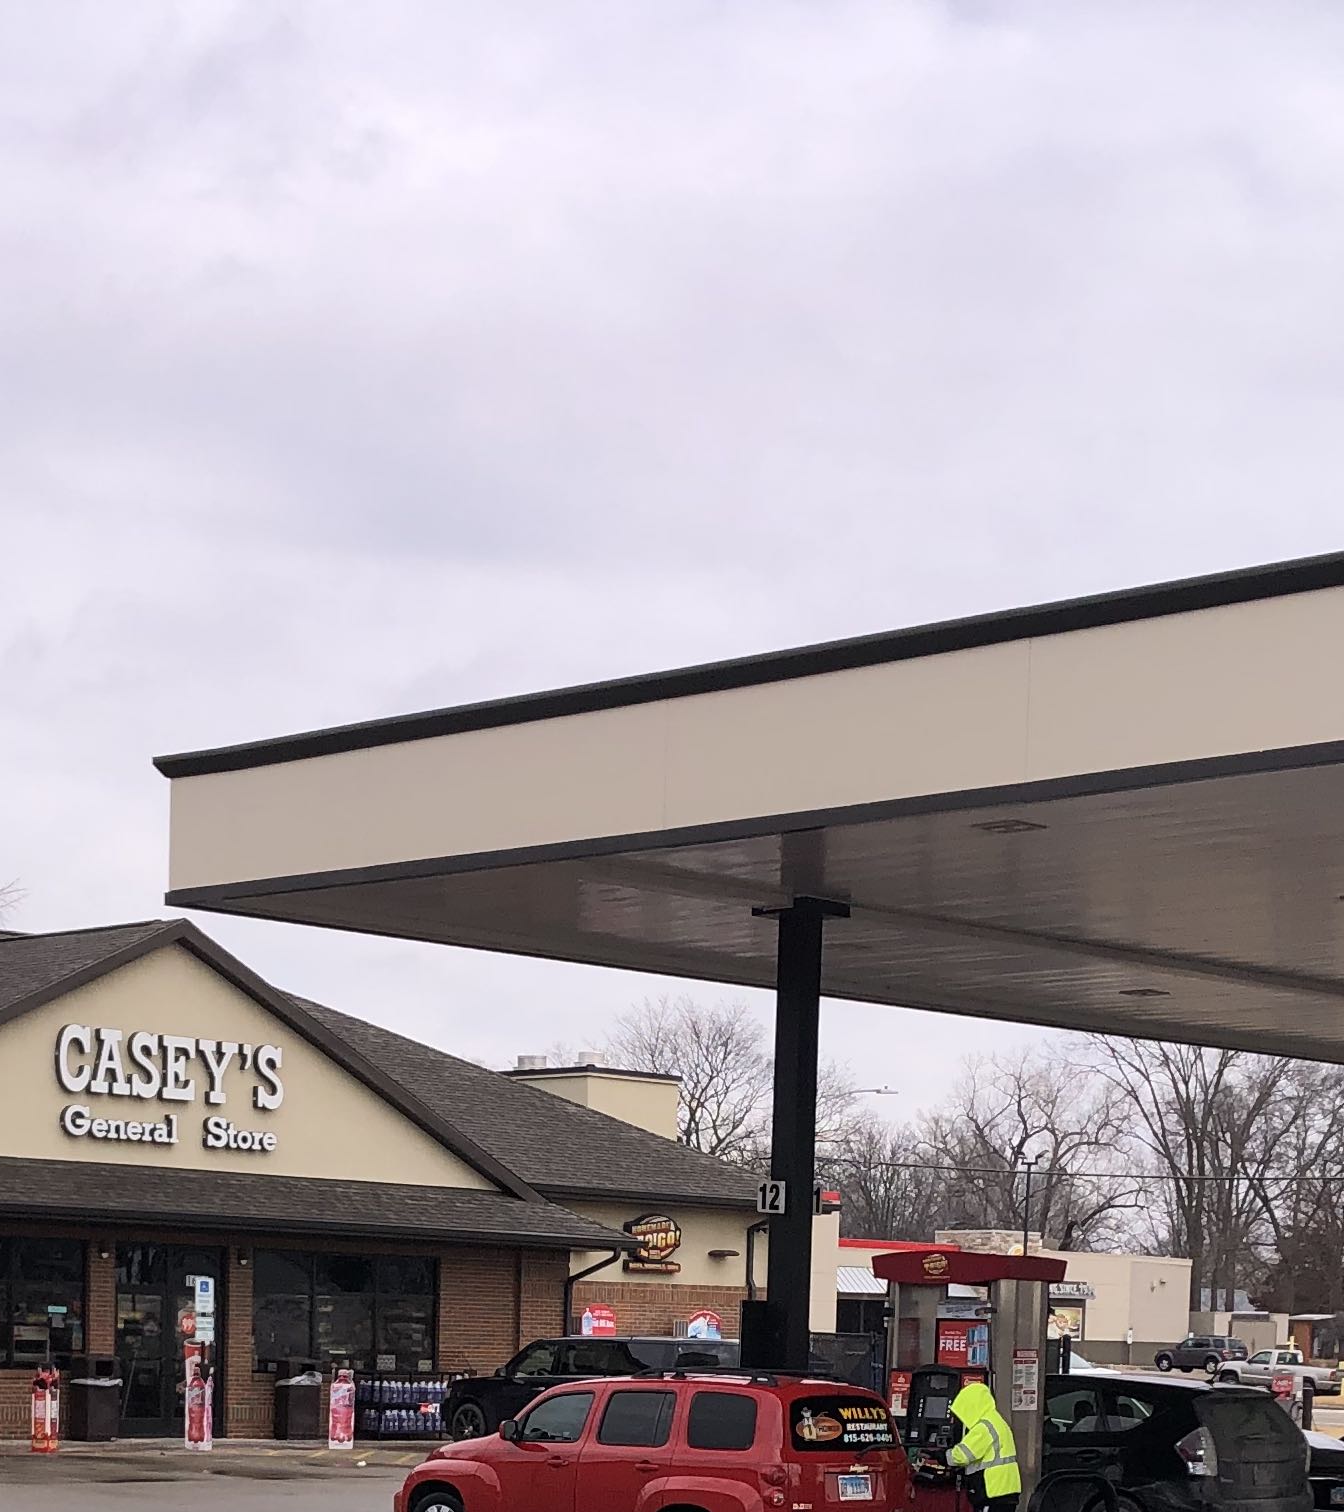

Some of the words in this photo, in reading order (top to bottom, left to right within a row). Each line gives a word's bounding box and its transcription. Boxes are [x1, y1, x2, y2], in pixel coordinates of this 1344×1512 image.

[58, 1023, 284, 1110] CASEY'S
[63, 1104, 179, 1143] General
[207, 1116, 278, 1151] Store
[759, 1183, 780, 1210] 12
[939, 1339, 967, 1351] FREE
[838, 1407, 887, 1420] WILLY'S
[846, 1423, 888, 1431] RESTAURANT
